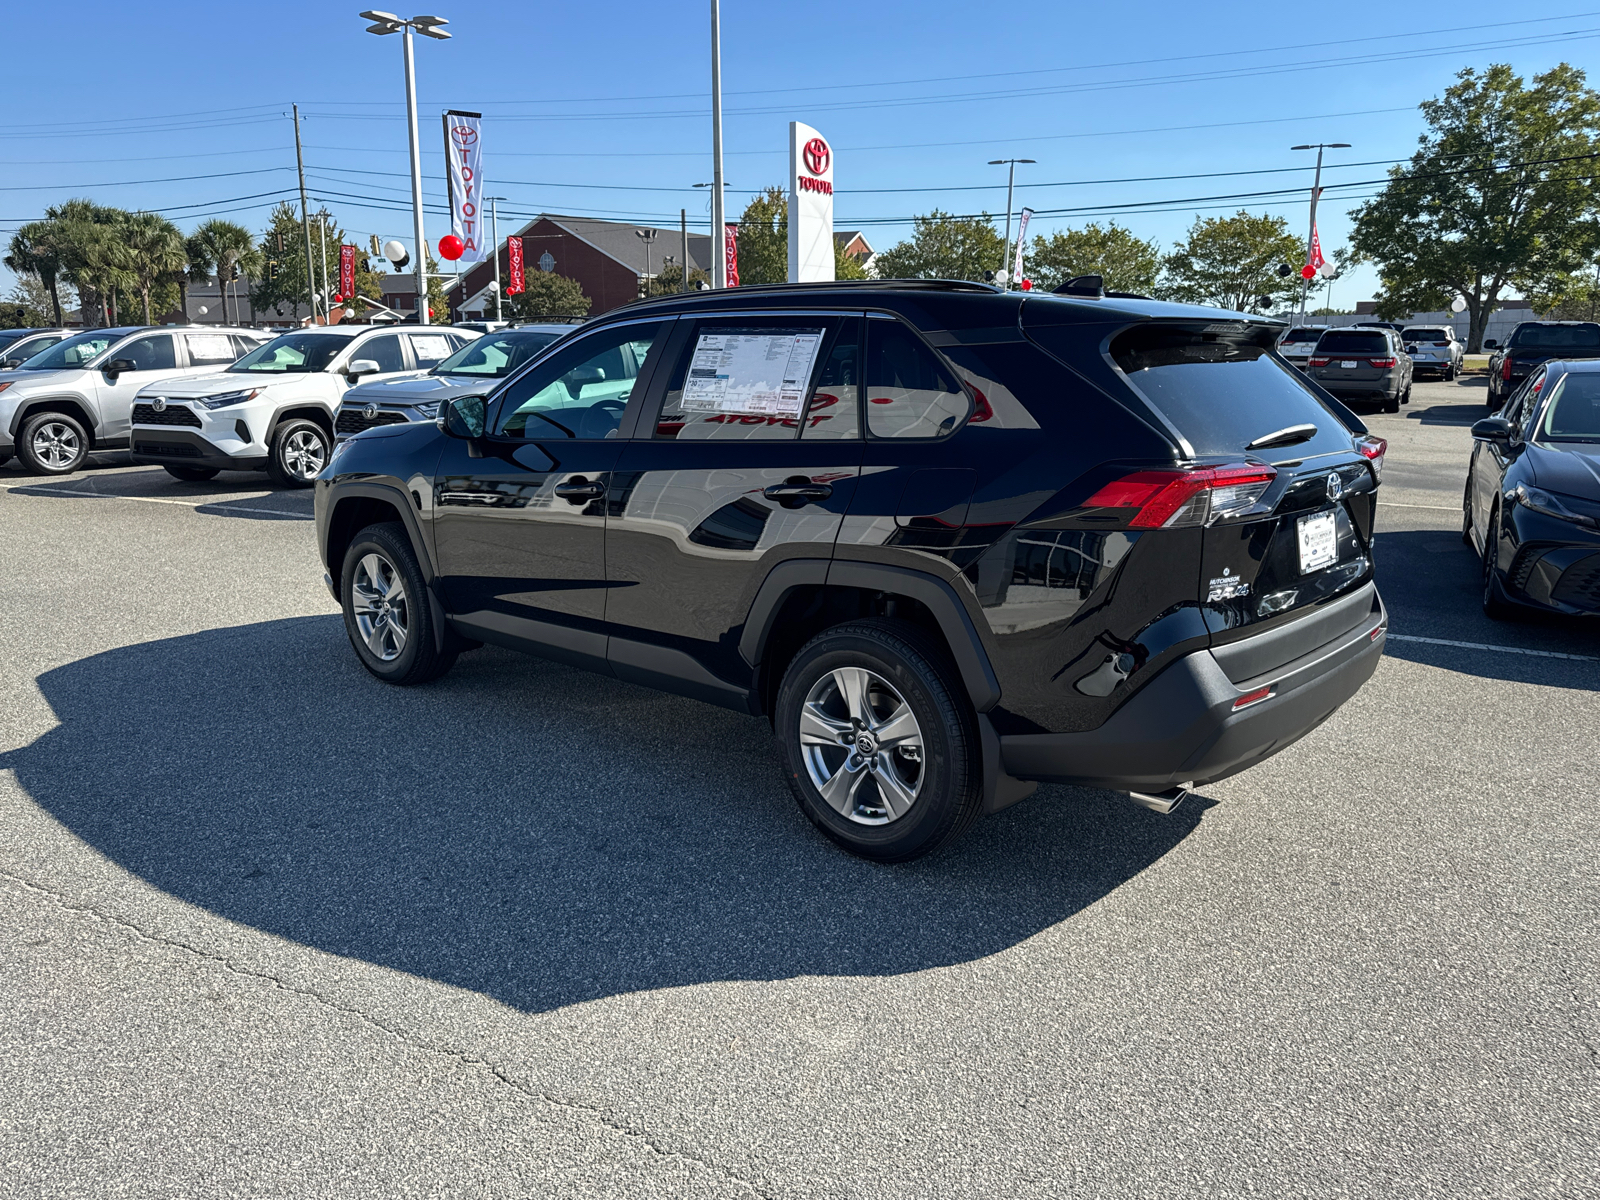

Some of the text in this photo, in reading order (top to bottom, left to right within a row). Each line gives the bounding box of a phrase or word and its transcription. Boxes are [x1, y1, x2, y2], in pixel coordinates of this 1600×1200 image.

[459, 149, 476, 251] TOYOTA
[798, 175, 833, 196] TOYOTA
[344, 257, 352, 297] TOYOTA
[513, 248, 521, 292] TOYOTA
[726, 238, 736, 287] TOYOTA
[1206, 582, 1250, 603] RAV4
